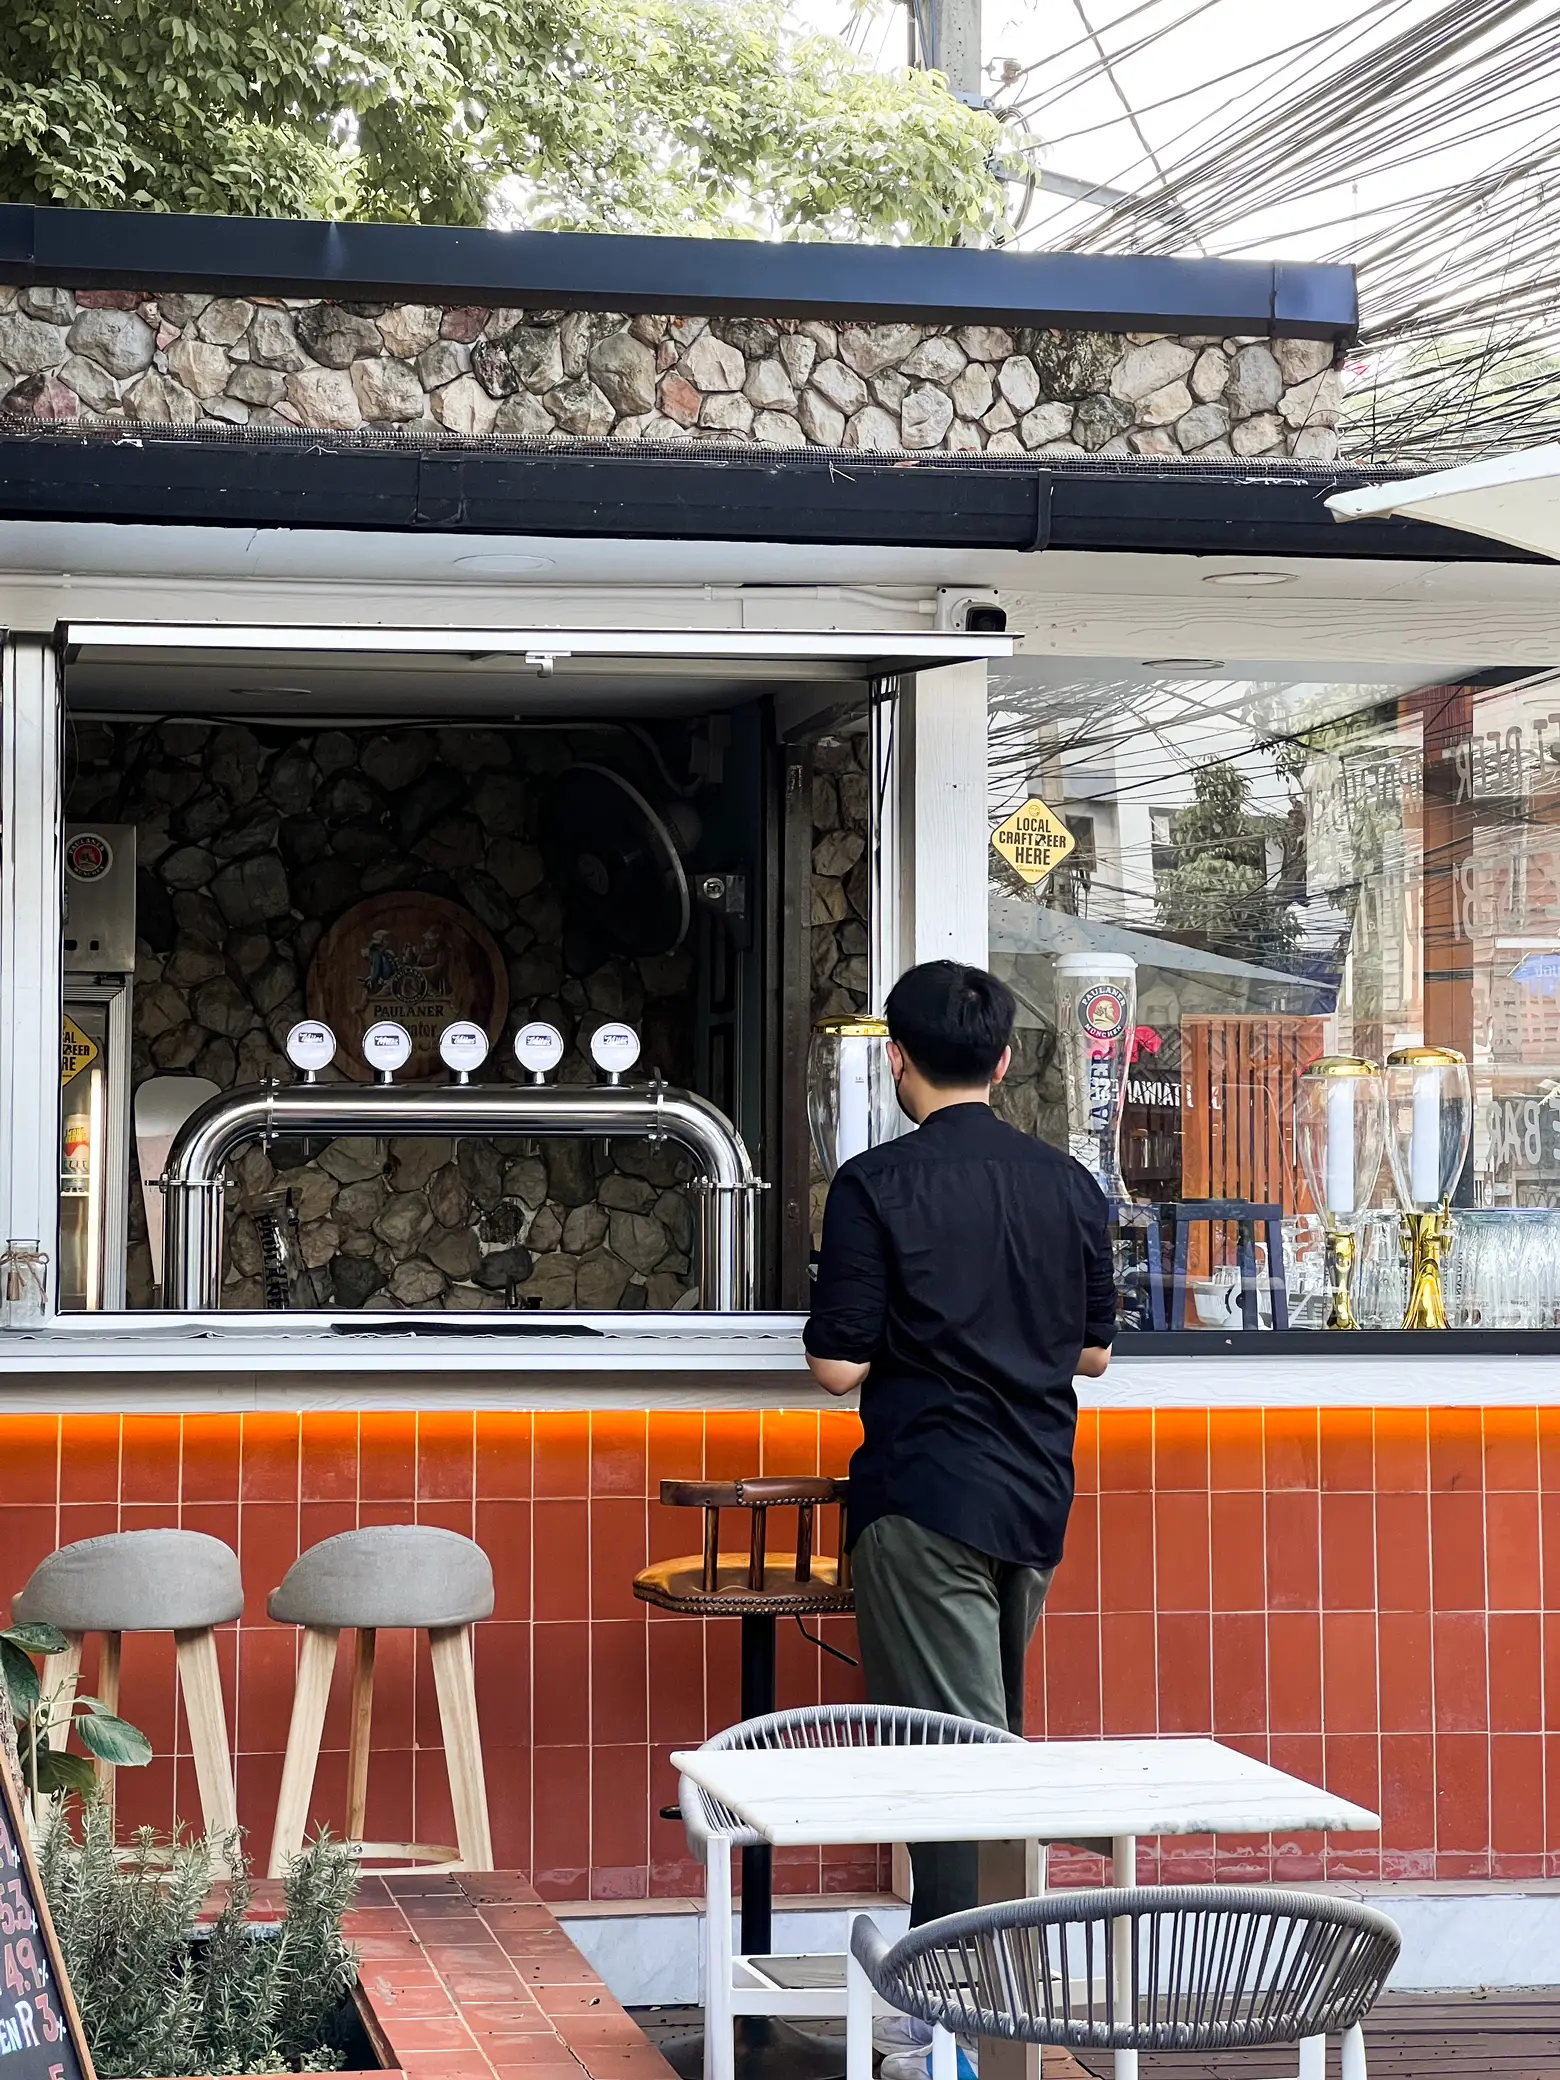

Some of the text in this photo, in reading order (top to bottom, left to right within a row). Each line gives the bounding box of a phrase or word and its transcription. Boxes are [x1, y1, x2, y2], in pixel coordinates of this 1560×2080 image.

[1017, 817, 1051, 833] LOCAL
[1015, 847, 1050, 865] HERE
[1082, 986, 1126, 1006] PAULANER
[374, 1004, 445, 1018] PAULANER
[4, 1937, 49, 1996] 4.9%
[35, 1993, 67, 2042] 3%
